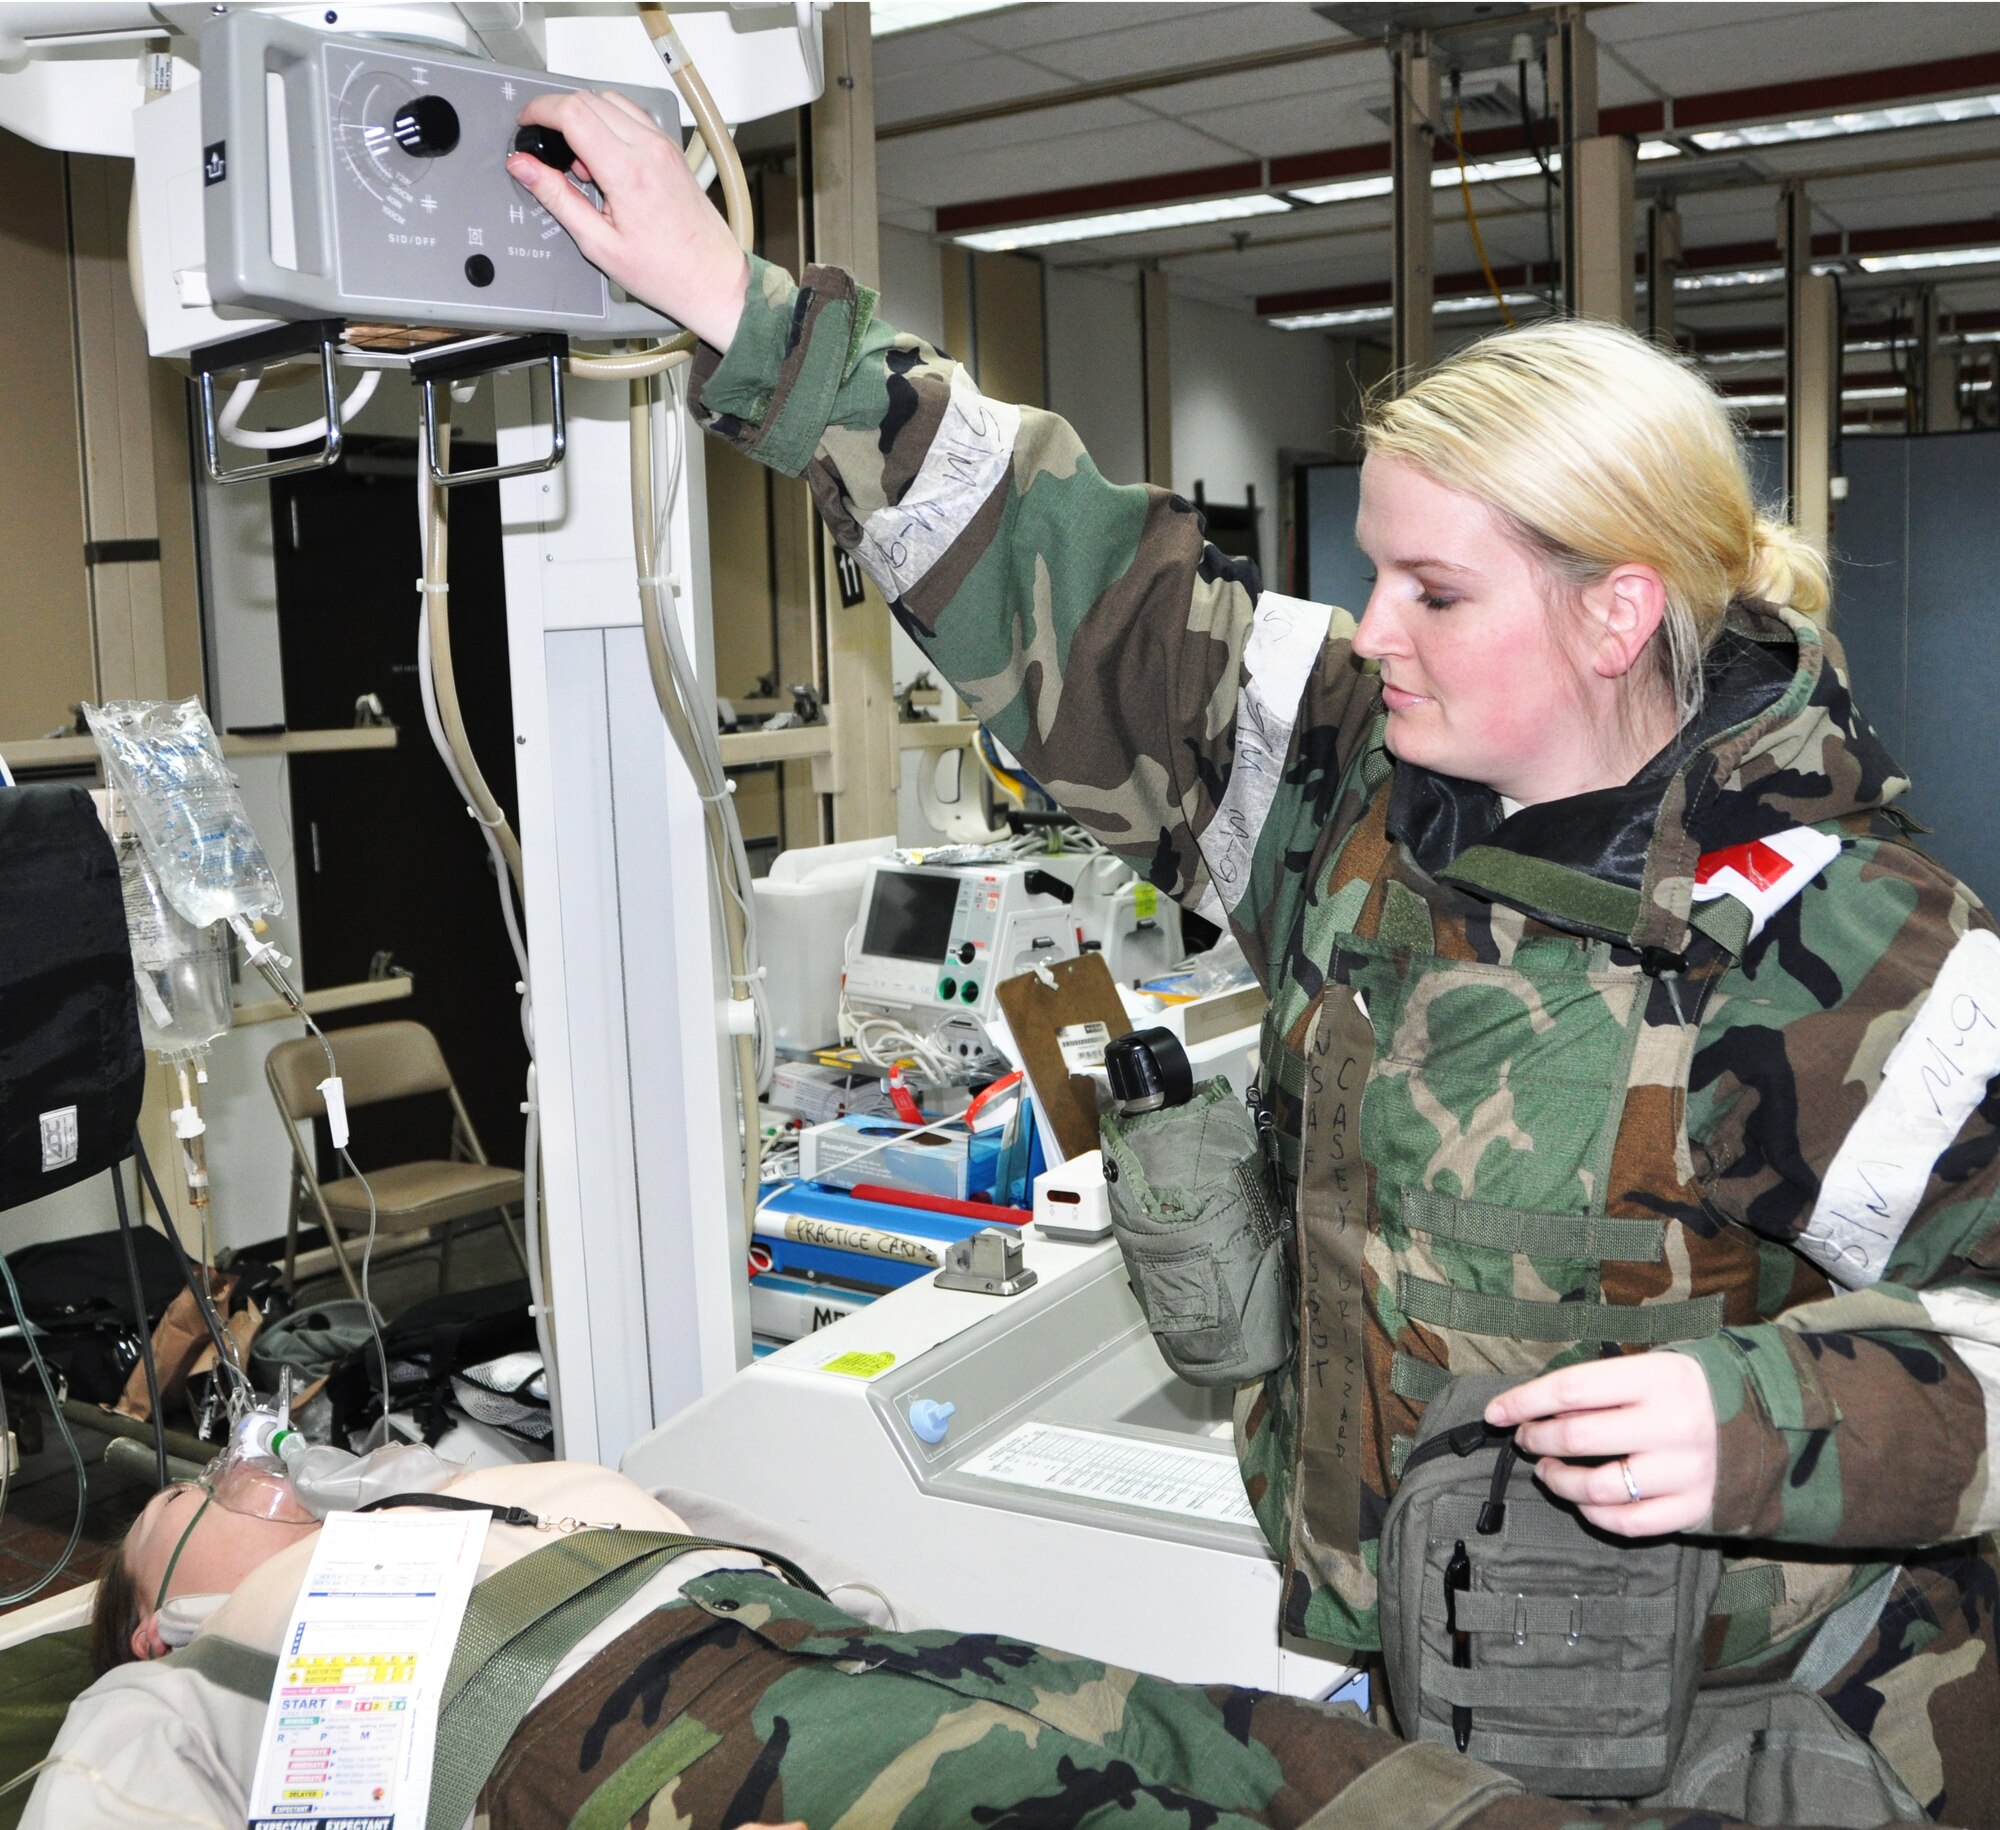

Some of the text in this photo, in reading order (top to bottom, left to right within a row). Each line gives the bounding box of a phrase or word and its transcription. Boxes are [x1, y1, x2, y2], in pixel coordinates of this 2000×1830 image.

[387, 233, 436, 247] SID/DFF
[507, 246, 552, 259] SID/DFF
[840, 552, 860, 597] 11
[1331, 1058, 1357, 1234] CASEY
[797, 1219, 871, 1251] PRACTICE
[282, 1699, 327, 1710] START
[277, 1734, 284, 1742] R
[320, 1733, 327, 1741] P
[255, 1819, 391, 1830] EXPECTANT EXPECTANT
